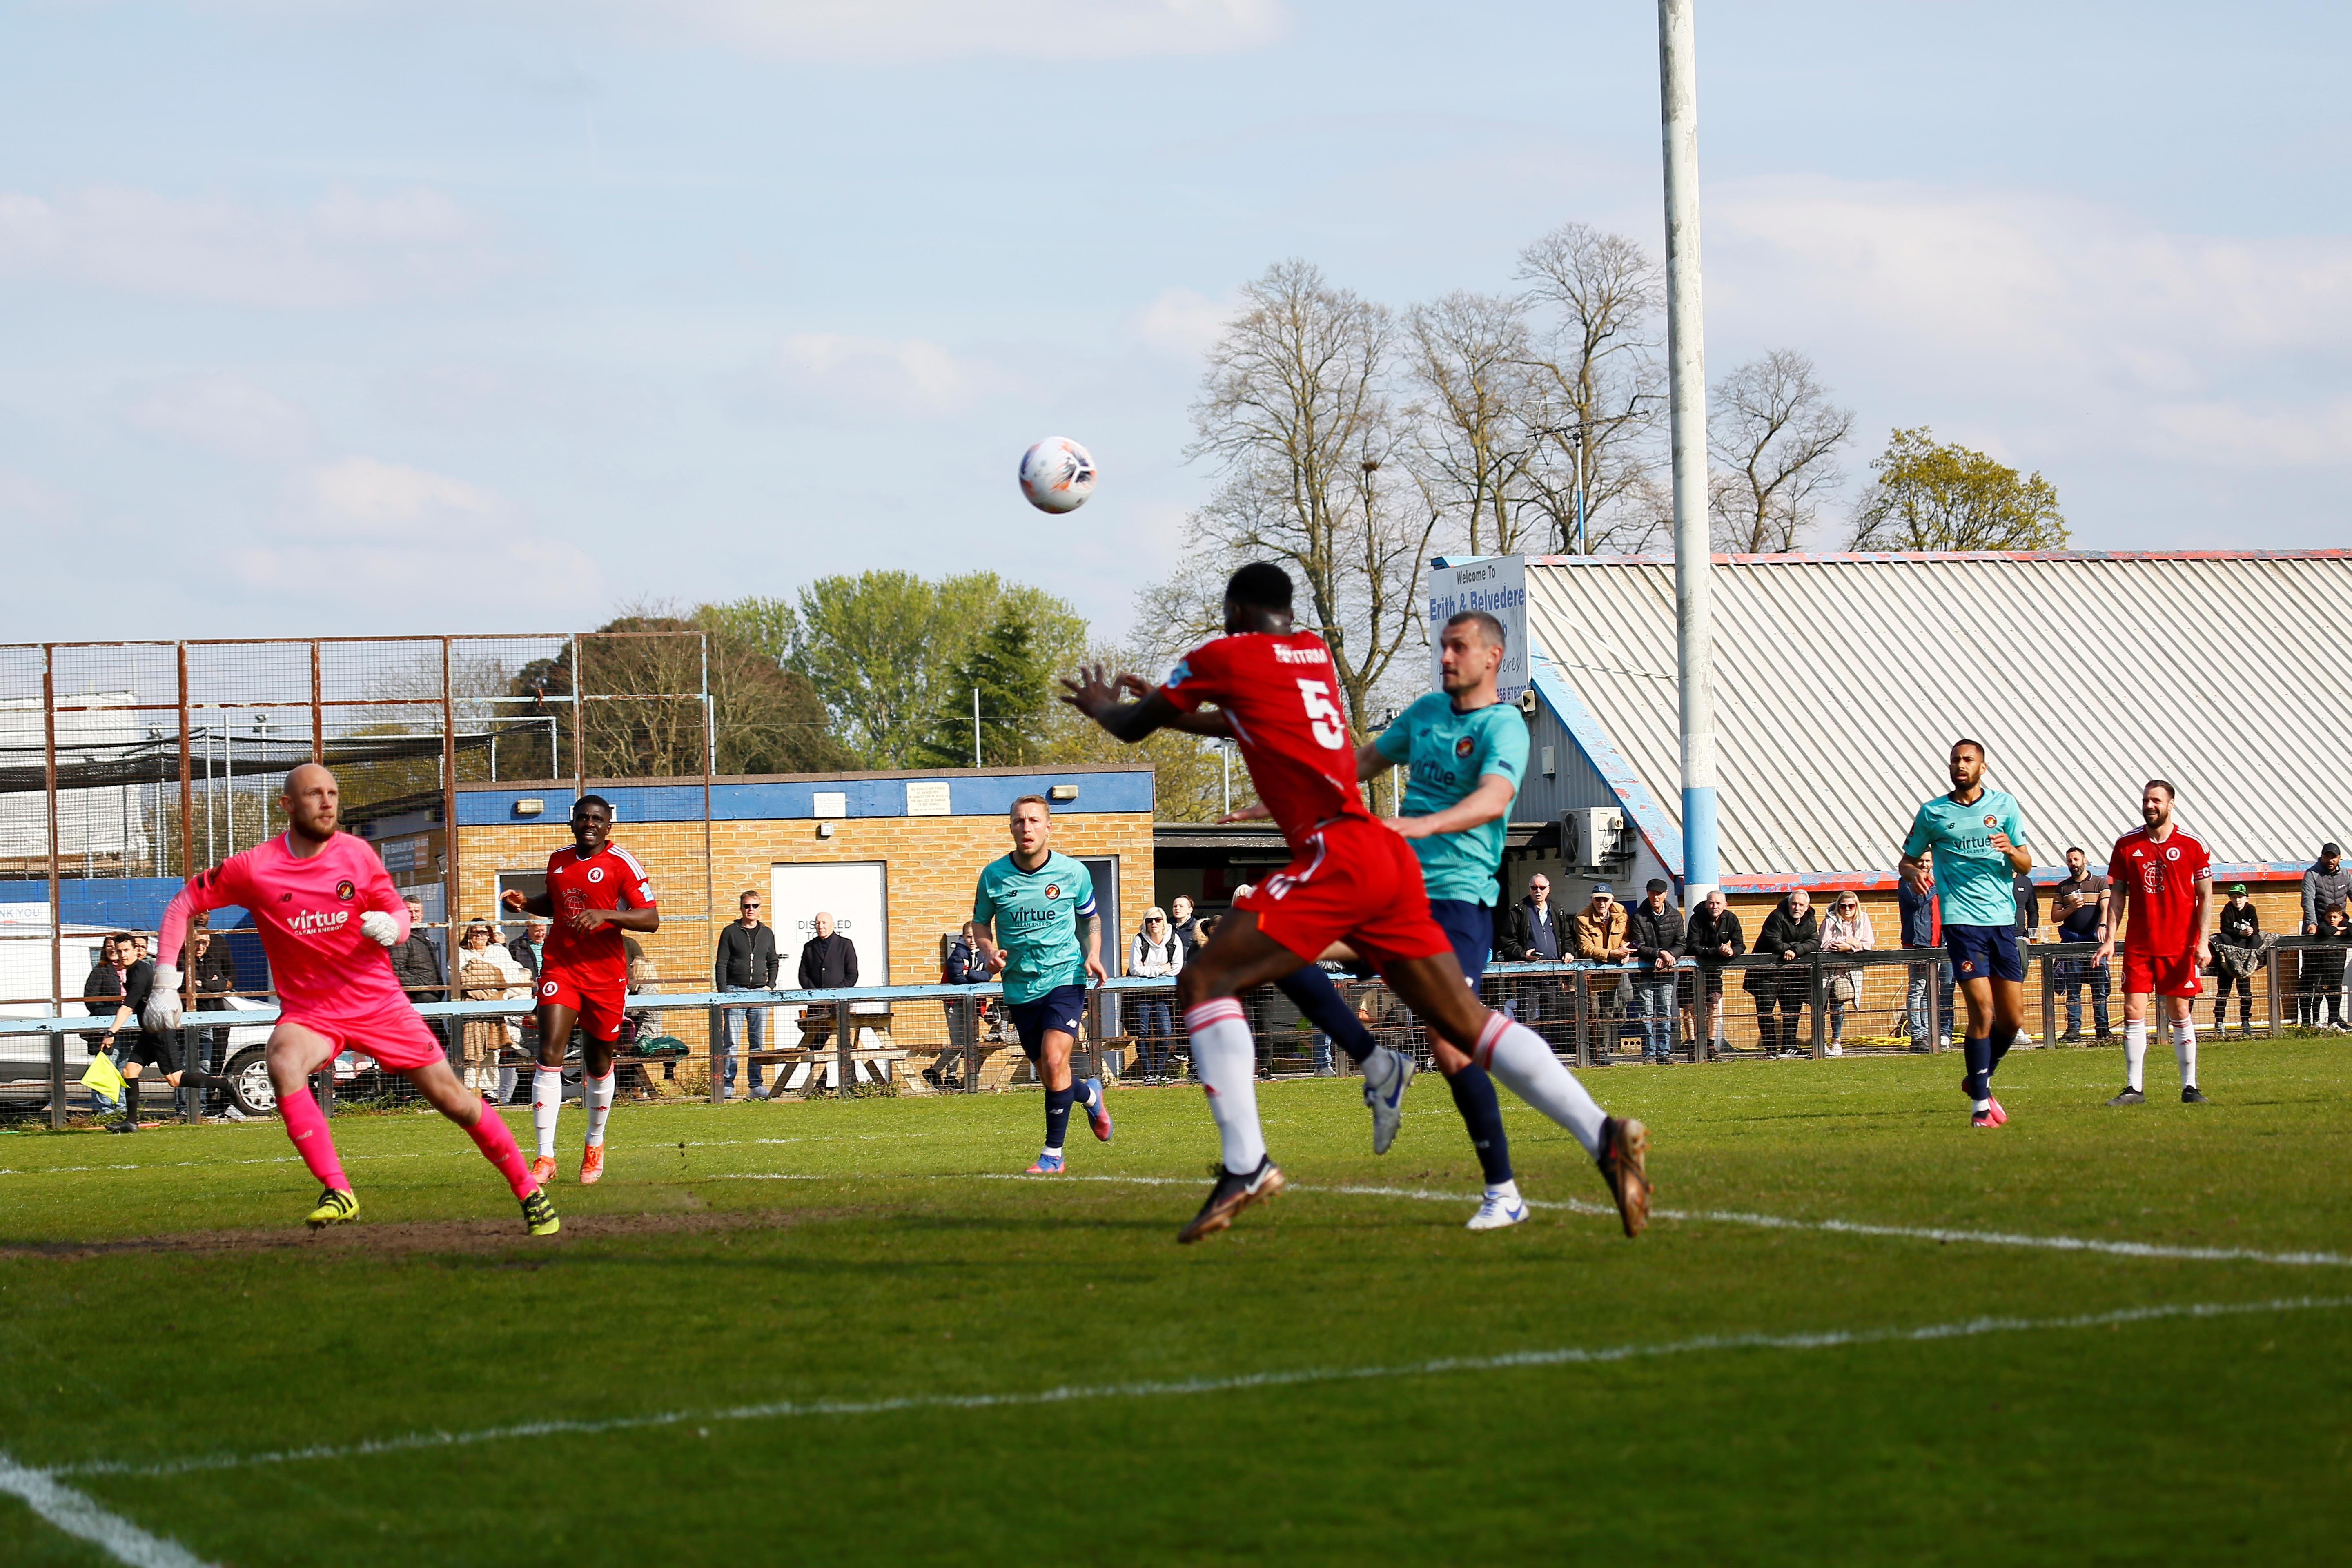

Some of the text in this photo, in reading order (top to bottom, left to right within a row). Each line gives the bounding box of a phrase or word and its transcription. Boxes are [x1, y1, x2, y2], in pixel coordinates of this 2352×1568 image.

[1457, 565, 1496, 585] Welcome To
[1430, 585, 1524, 621] Erith & Belvedere
[1296, 677, 1345, 750] 5
[1954, 836, 1991, 850] virtue
[2202, 866, 2210, 877] C
[287, 909, 348, 930] virtue
[1009, 906, 1056, 922] virtue
[318, 924, 343, 933] ENERGY
[798, 920, 851, 929] DISED
